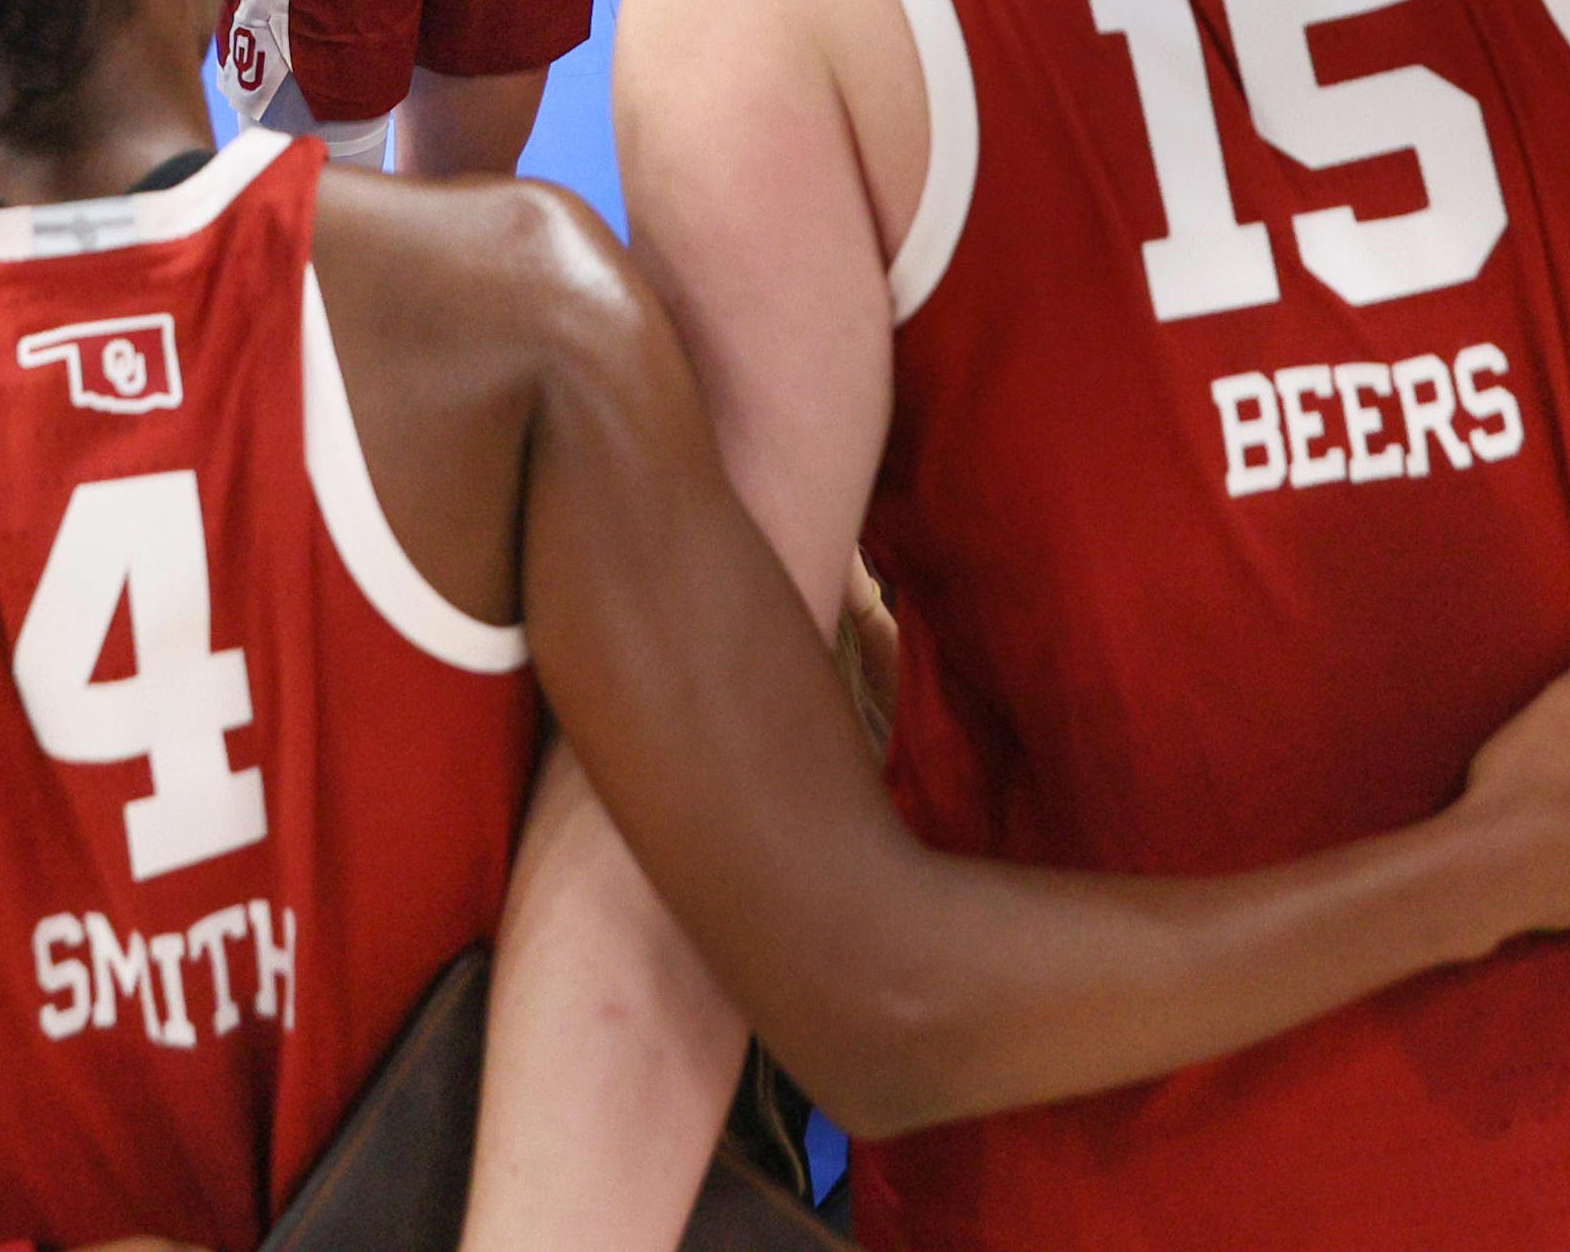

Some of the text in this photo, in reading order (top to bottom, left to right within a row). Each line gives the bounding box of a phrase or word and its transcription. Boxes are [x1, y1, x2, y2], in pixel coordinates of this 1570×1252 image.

[232, 27, 267, 92] OU
[103, 338, 146, 395] OU
[1211, 343, 1525, 499] BEERS
[12, 469, 269, 882] 4
[32, 899, 297, 1048] SMITH
